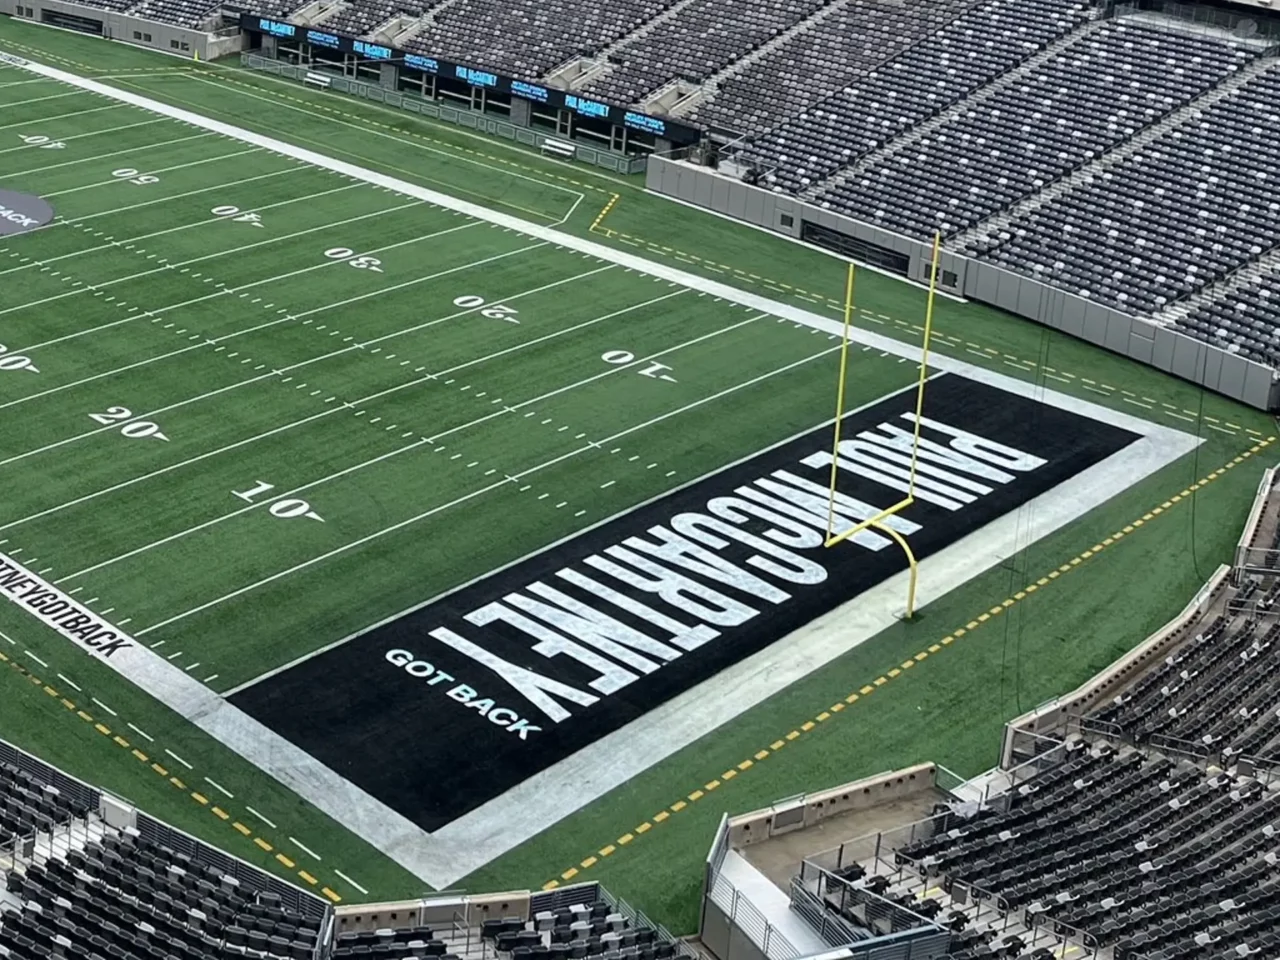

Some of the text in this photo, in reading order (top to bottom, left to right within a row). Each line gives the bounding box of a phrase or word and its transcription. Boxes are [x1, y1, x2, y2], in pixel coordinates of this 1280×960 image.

[24, 135, 66, 150] 40
[112, 168, 159, 185] 50
[211, 205, 261, 225] 40
[323, 247, 379, 269] 30
[453, 295, 519, 320] 20
[600, 350, 673, 378] 10
[88, 406, 159, 438] 20
[231, 480, 310, 518] 10
[427, 411, 1048, 723] PAUL McCARTNEY
[385, 648, 543, 740] GOT BACK
